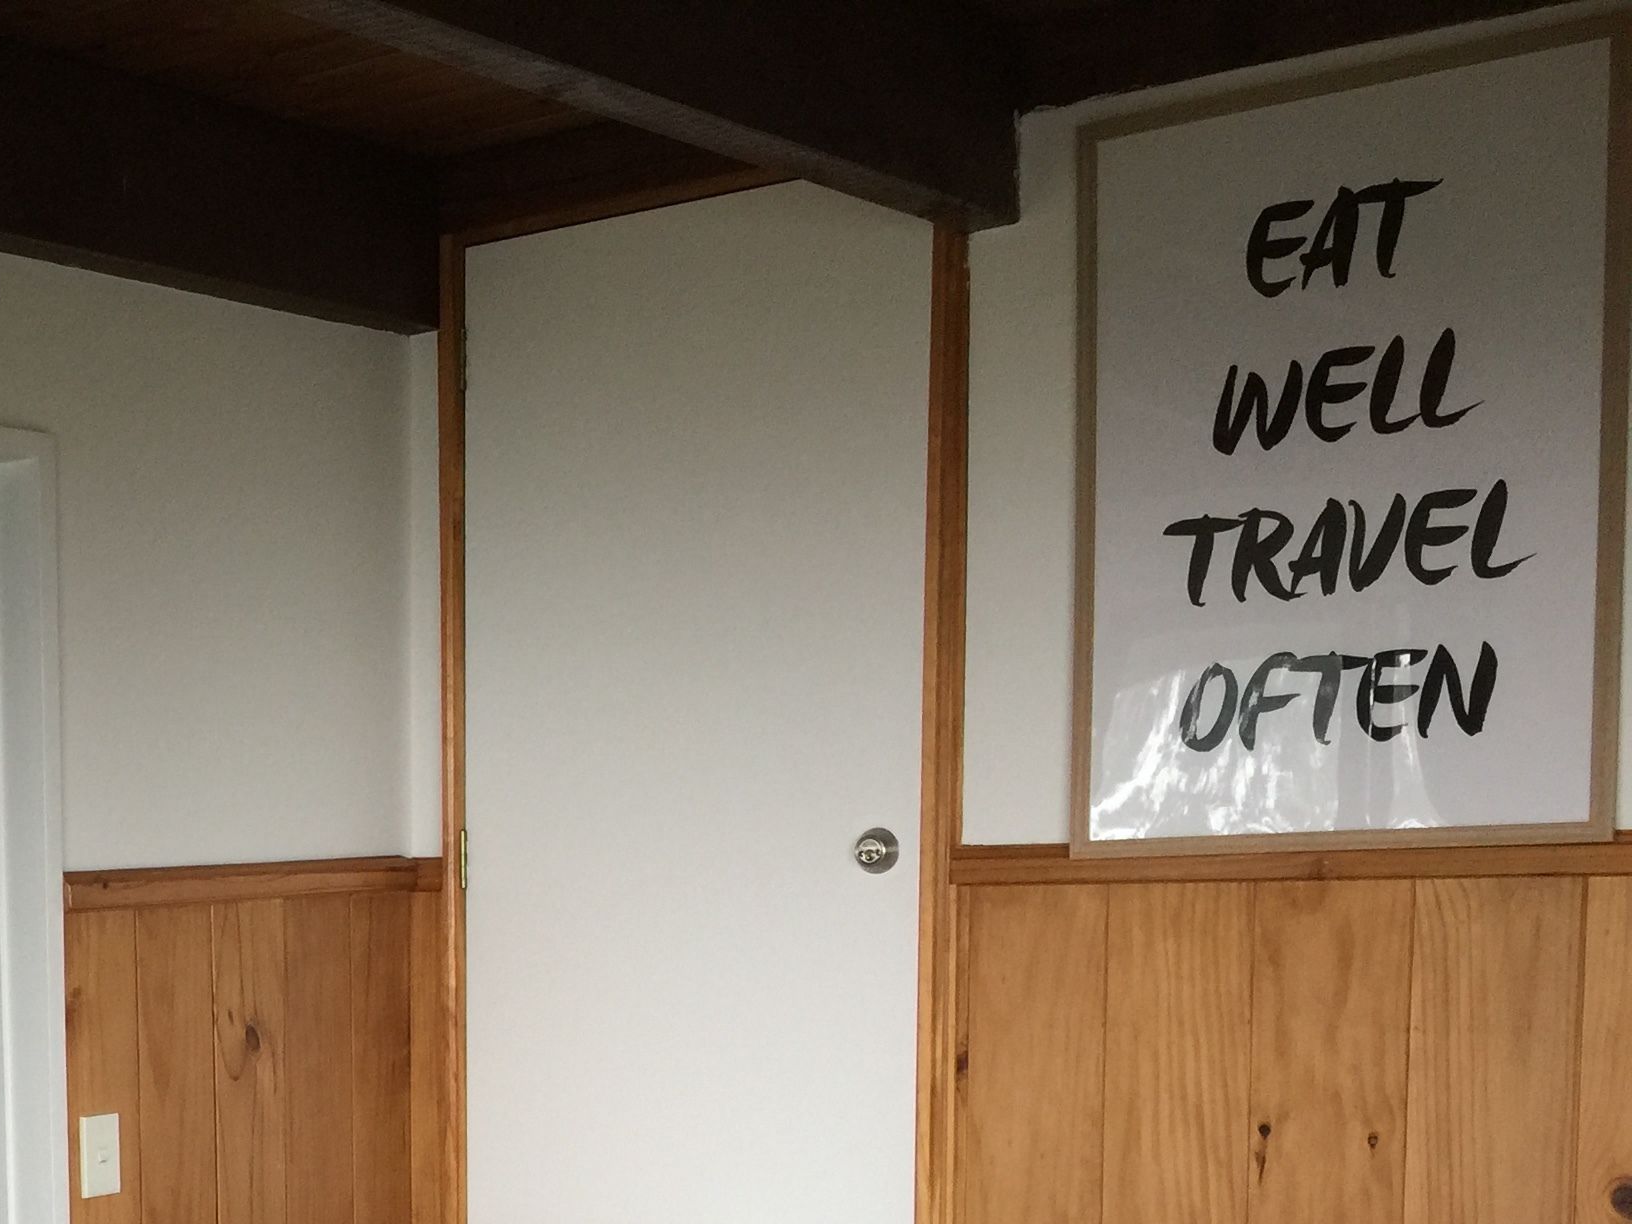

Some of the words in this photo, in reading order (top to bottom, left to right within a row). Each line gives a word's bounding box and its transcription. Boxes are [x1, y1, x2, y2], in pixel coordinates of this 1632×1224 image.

[1246, 178, 1443, 298] EAT
[1211, 327, 1485, 456] WELL
[1163, 479, 1537, 607] TRAVEL
[1178, 641, 1498, 753] OFTEN
